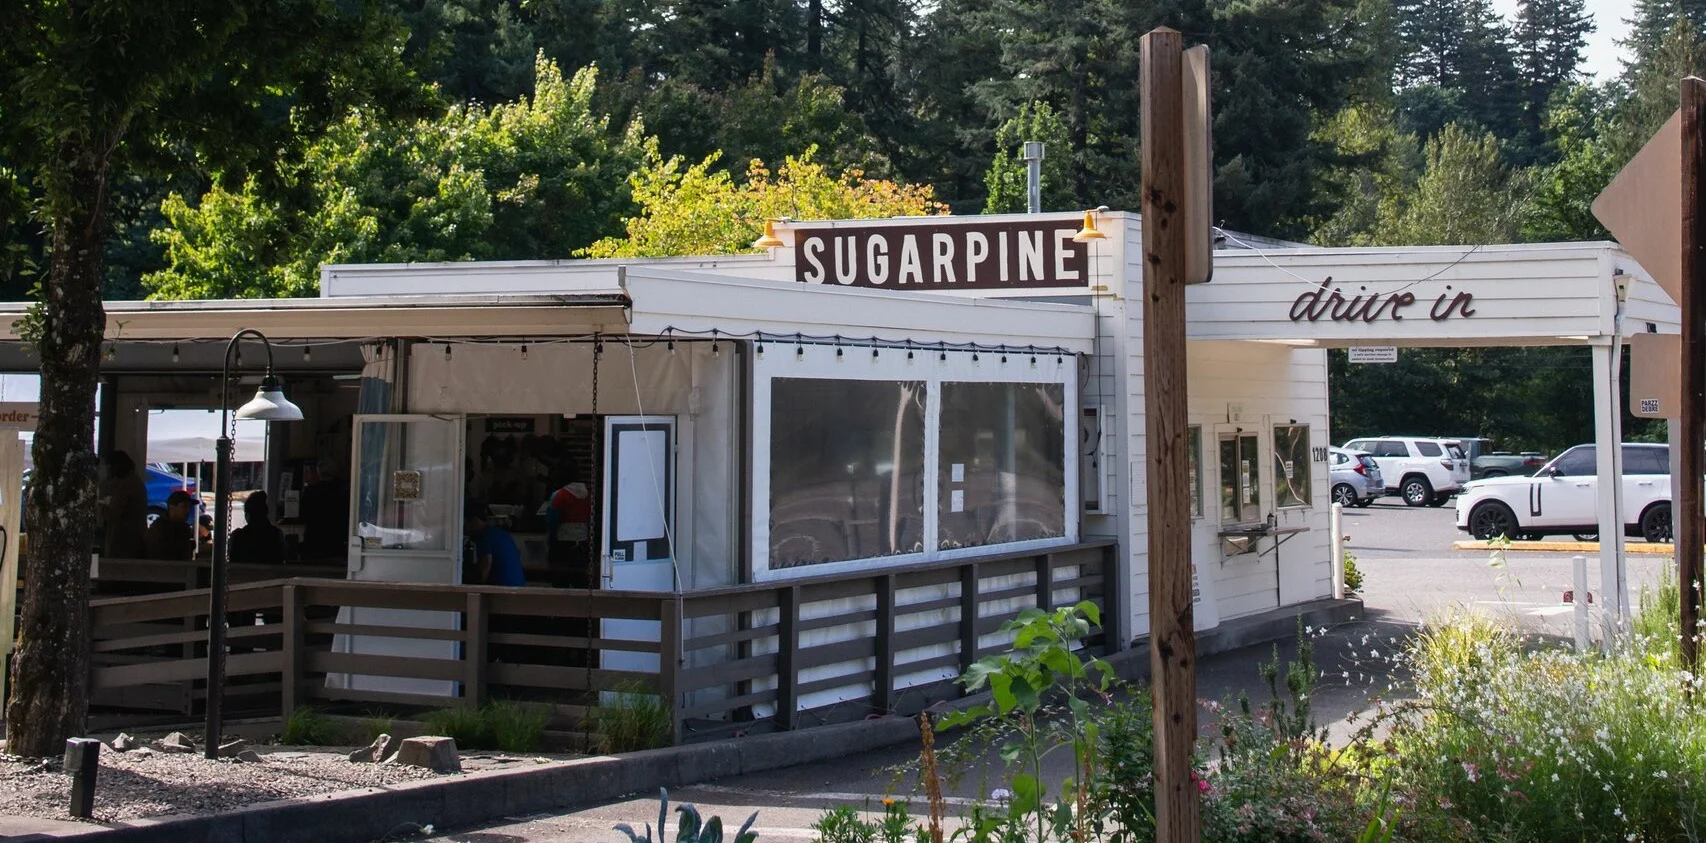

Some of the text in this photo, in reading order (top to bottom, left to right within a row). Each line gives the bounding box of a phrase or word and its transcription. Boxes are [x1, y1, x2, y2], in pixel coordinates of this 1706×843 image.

[803, 229, 1079, 285] SUGARPINE
[1289, 276, 1476, 323] drive in
[0, 410, 29, 422] rder
[1312, 447, 1328, 462] 1208
